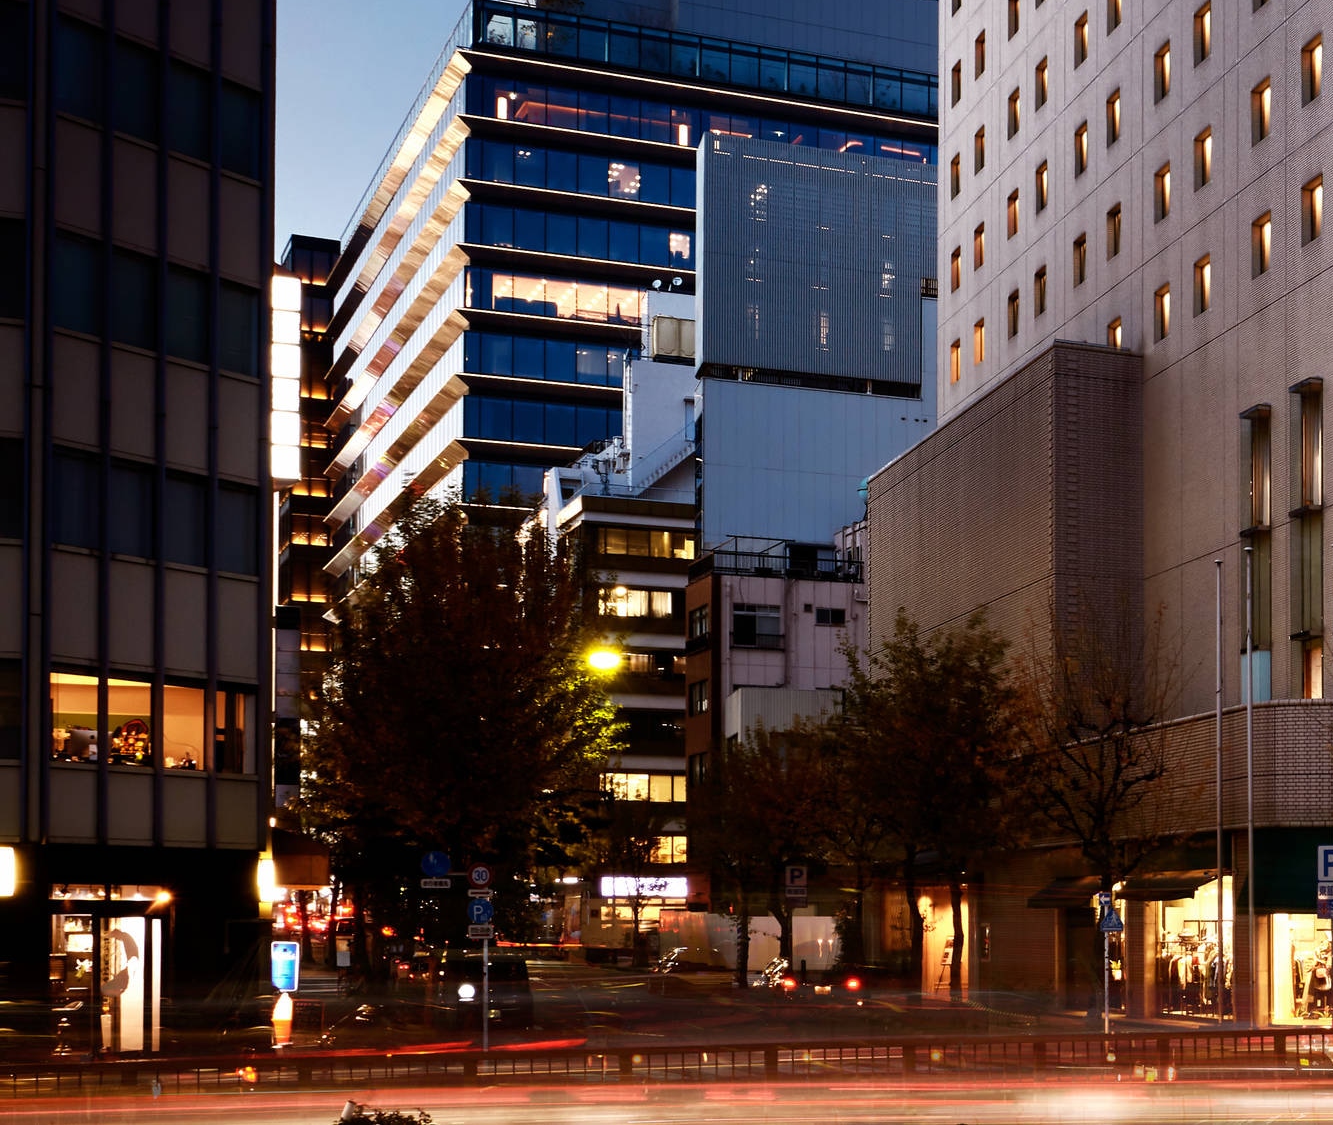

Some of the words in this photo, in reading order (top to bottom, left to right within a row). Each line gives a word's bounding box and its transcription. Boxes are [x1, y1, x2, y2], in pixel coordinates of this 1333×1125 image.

[474, 869, 488, 882] 30
[790, 868, 803, 884] P
[474, 905, 483, 921] P
